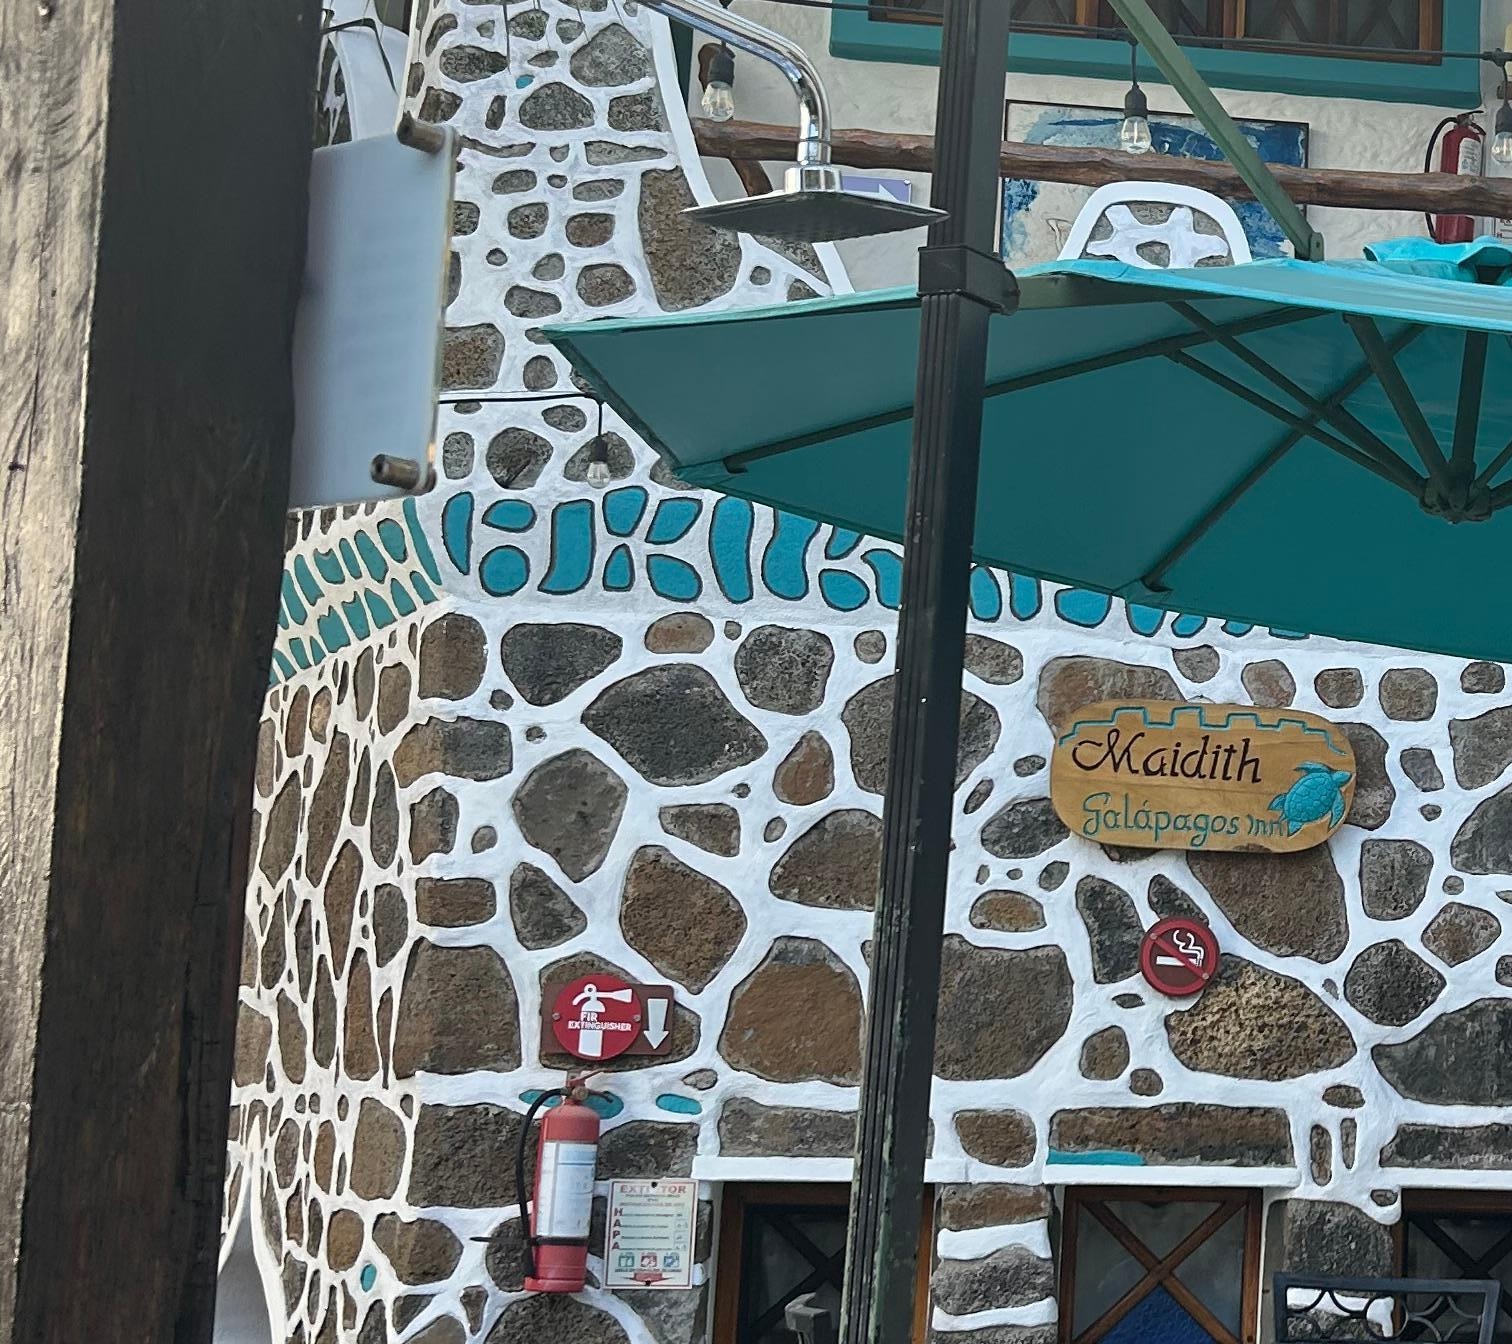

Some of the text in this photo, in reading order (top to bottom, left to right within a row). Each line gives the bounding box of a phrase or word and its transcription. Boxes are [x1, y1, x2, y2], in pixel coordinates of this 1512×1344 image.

[1072, 728, 1262, 783] Maidith
[1082, 792, 1240, 847] Galápagos
[568, 1021, 632, 1031] EXTINGUISHER
[620, 1184, 687, 1194] EXTITOR
